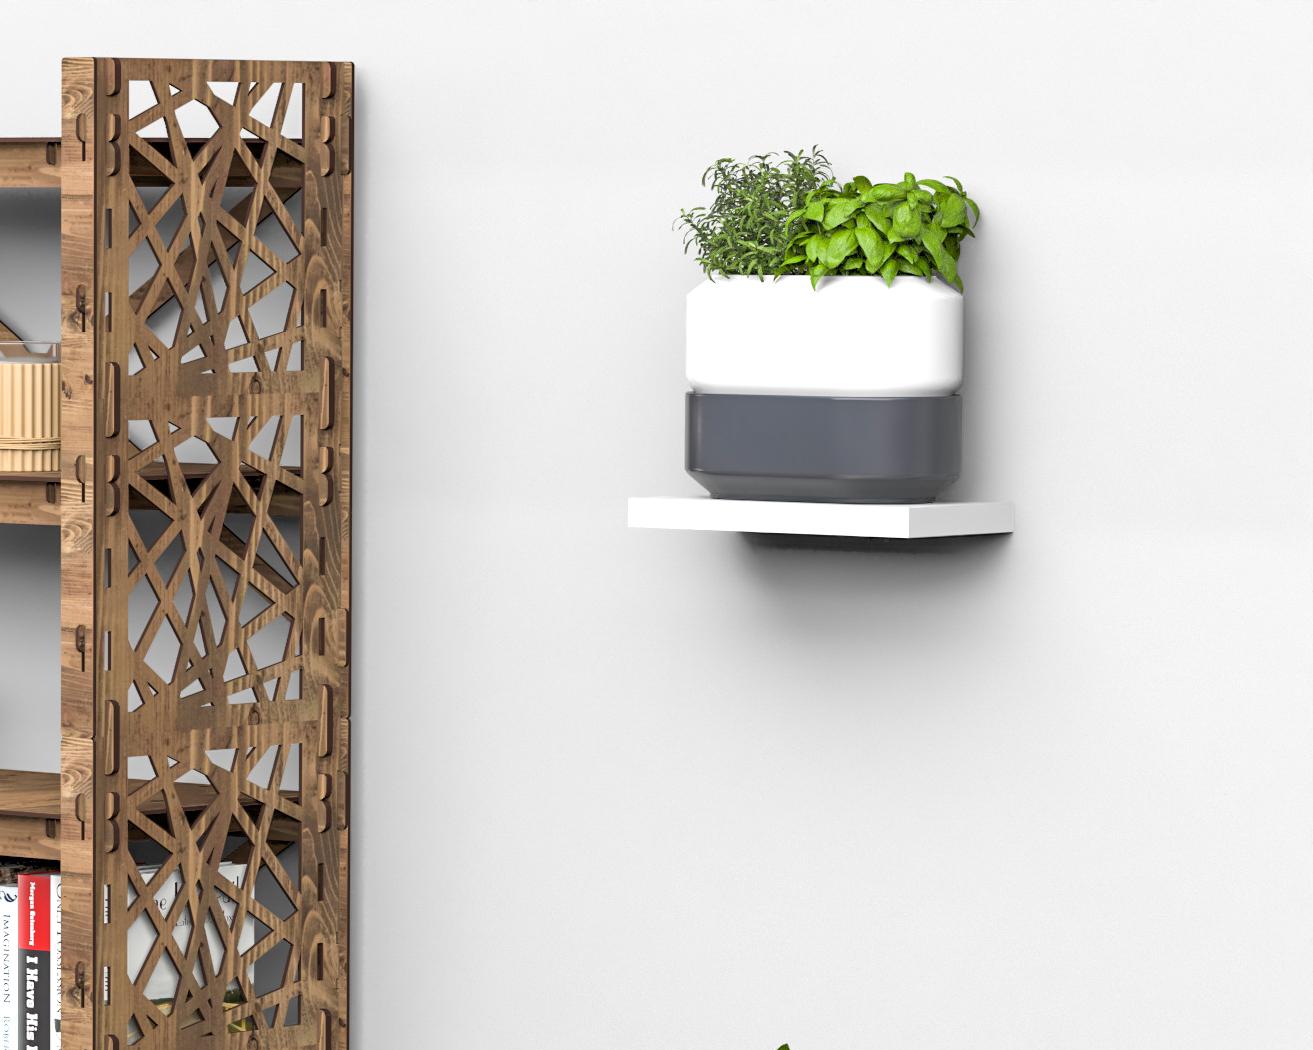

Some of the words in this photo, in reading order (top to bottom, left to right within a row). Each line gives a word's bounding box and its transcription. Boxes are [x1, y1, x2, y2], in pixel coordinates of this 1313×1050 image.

[26, 955, 38, 965] I
[26, 967, 38, 1009] Have
[26, 1012, 38, 1041] His
